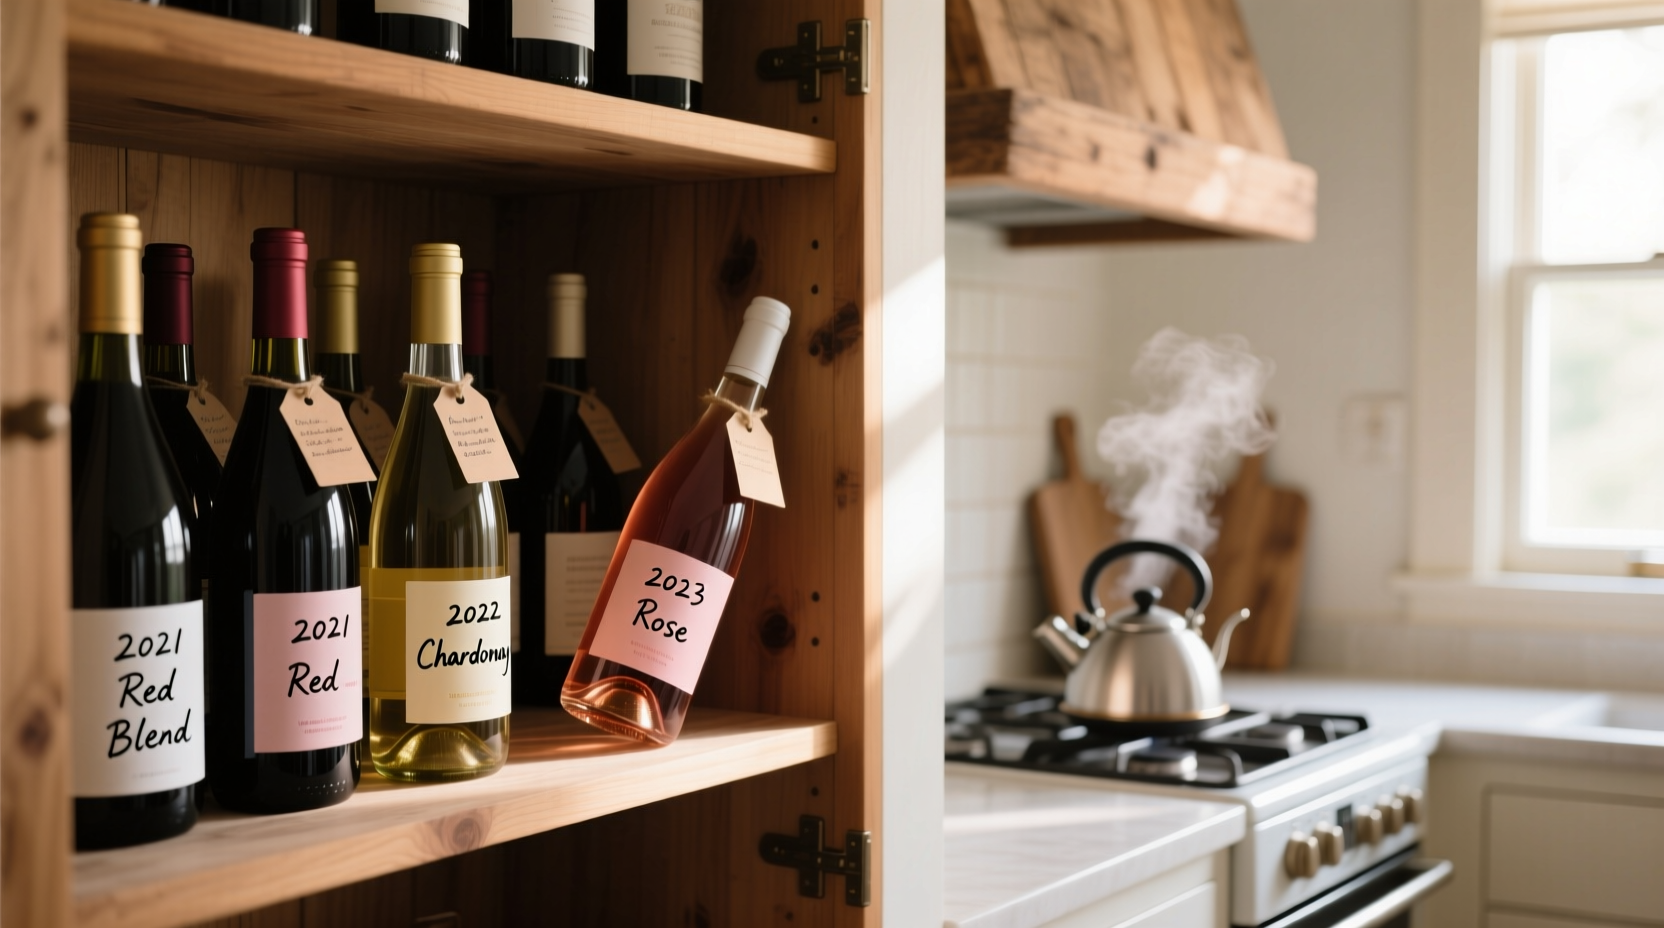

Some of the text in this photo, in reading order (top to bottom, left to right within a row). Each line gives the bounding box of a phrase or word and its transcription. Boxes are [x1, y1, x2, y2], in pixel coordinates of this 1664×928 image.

[644, 567, 705, 606] 2023
[290, 614, 350, 644] 2021
[445, 601, 502, 627] 2022
[632, 598, 688, 643] Rose
[113, 628, 182, 662] 2021
[118, 668, 177, 709] Red
[287, 658, 340, 698] Red
[106, 707, 192, 759] Blend
